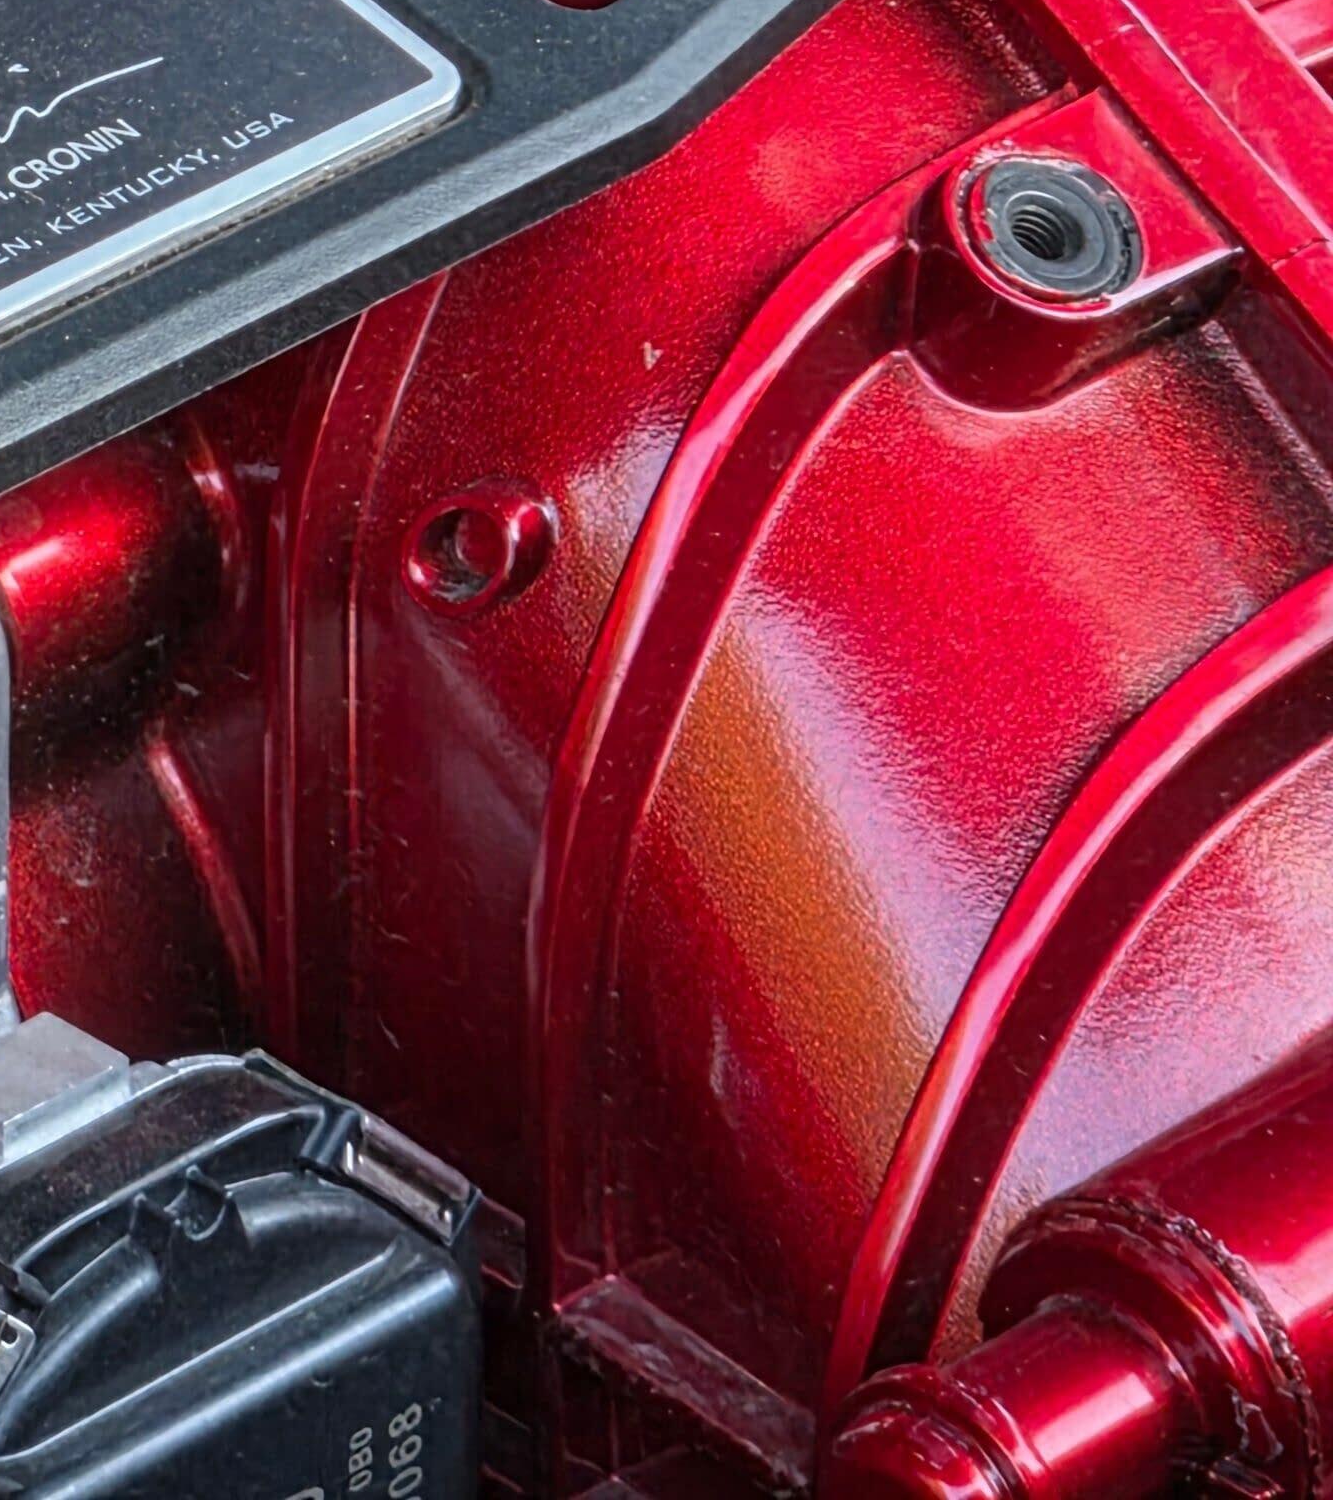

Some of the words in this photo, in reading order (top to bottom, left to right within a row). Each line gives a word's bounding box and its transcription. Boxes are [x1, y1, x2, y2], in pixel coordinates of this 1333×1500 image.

[46, 146, 220, 235] KENTUCKY,
[221, 111, 294, 150] USA
[389, 1403, 422, 1500] 068
